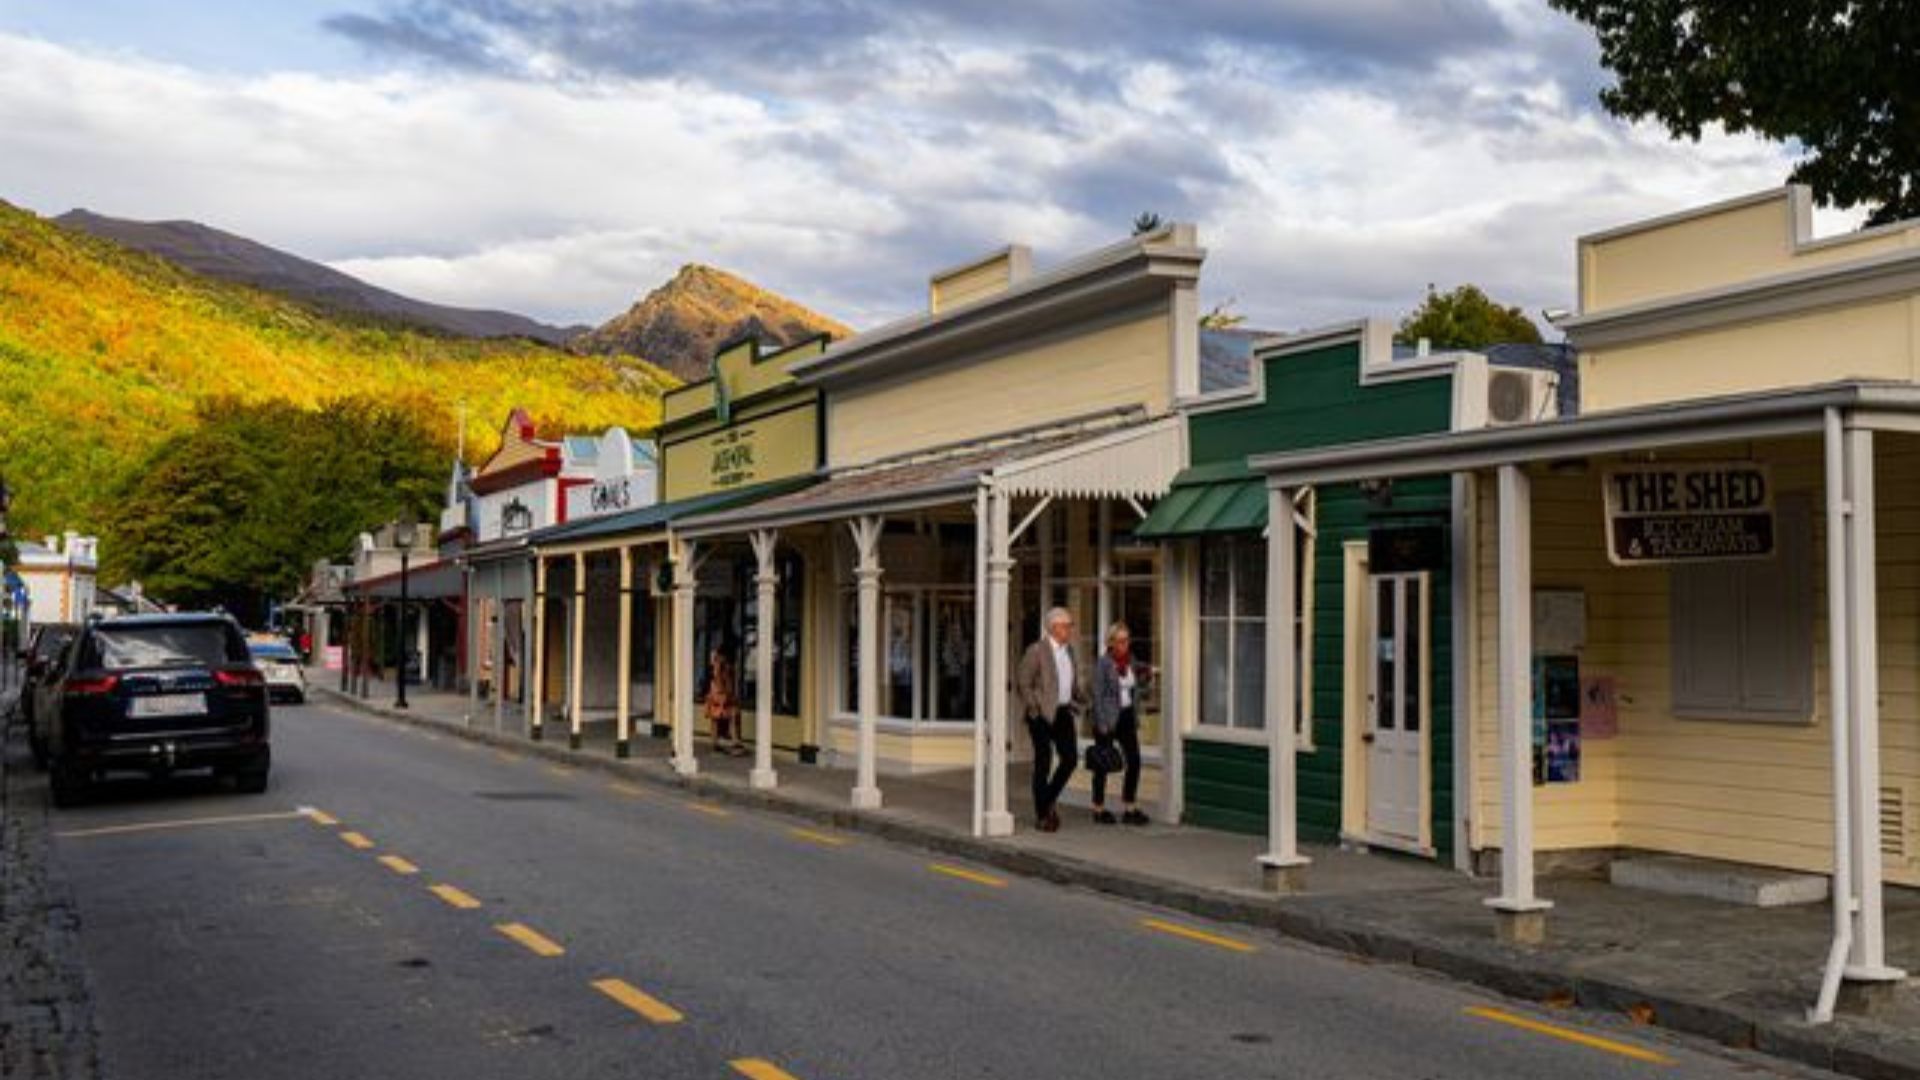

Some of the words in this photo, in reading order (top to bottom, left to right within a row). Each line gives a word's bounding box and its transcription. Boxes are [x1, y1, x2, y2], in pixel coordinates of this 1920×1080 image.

[1613, 471, 1679, 512] THE
[1685, 469, 1765, 509] SHED
[1628, 537, 1643, 557] &
